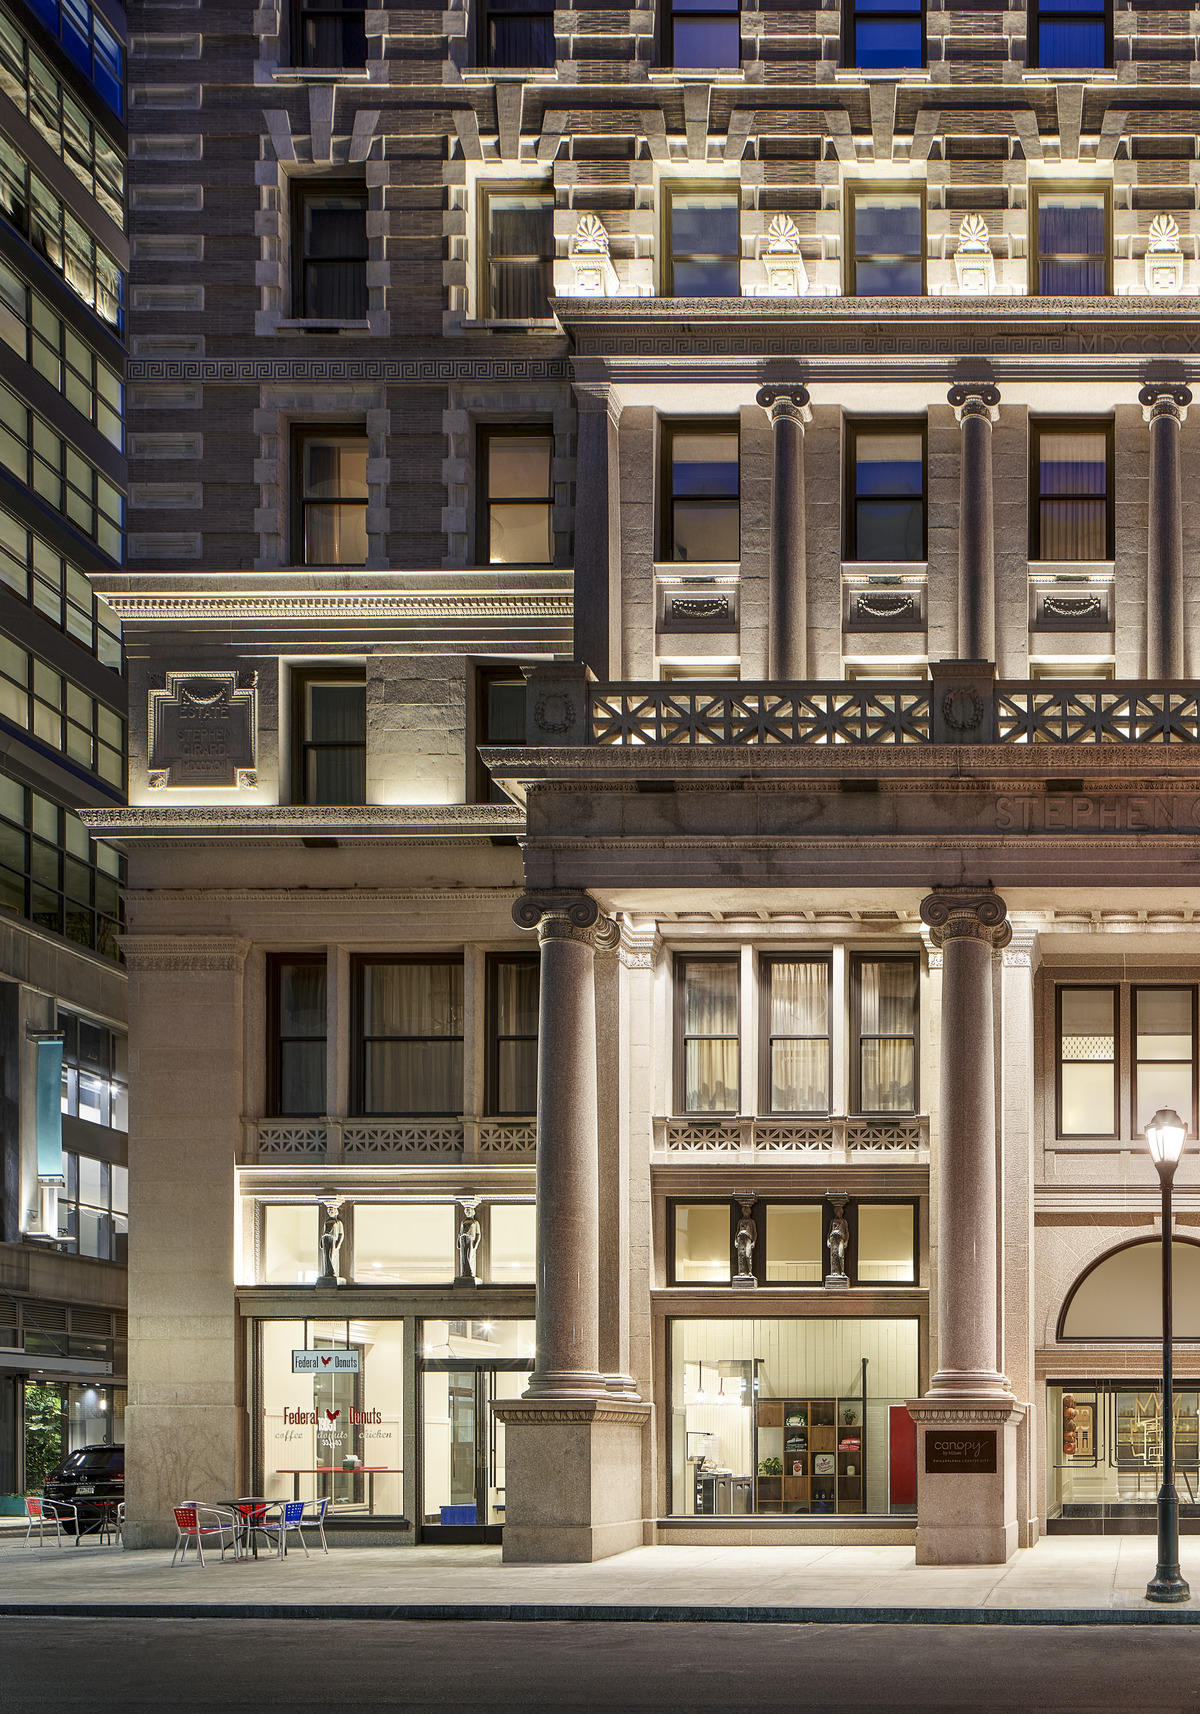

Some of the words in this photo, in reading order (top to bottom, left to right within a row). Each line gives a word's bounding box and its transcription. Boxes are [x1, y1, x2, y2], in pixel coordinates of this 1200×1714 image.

[179, 706, 229, 719] ESTATE
[178, 729, 232, 742] STEPHEN
[995, 796, 1180, 831] STEPHEN
[295, 1355, 319, 1368] Federal
[334, 1355, 358, 1368] Donuts
[283, 1406, 319, 1425] Federal
[349, 1406, 382, 1425] Donuts
[275, 1430, 303, 1441] coffee
[358, 1430, 392, 1439] chicken
[934, 1440, 989, 1457] canopy
